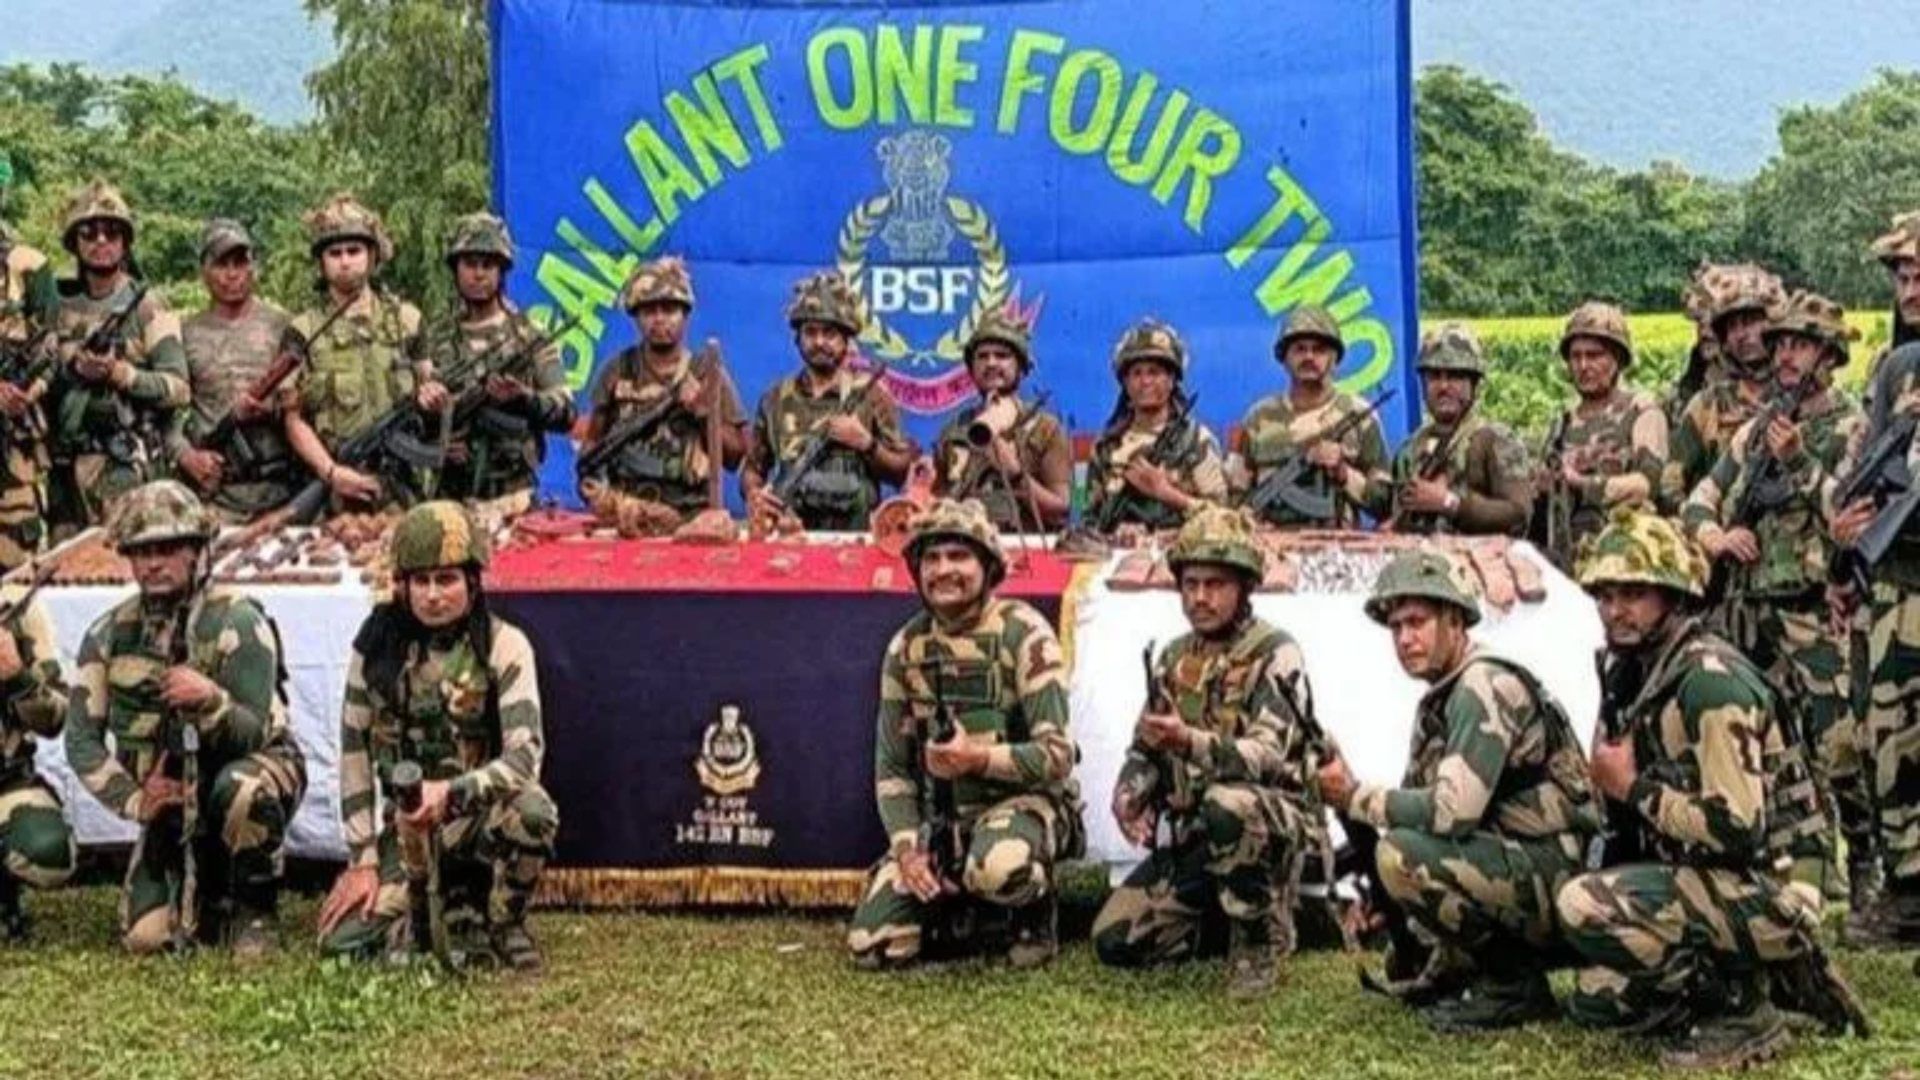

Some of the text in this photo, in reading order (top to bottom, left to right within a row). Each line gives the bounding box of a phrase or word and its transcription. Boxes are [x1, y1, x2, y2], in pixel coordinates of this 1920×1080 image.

[806, 24, 985, 129] ONE
[996, 29, 1242, 234] FOUR
[872, 266, 974, 314] BSF
